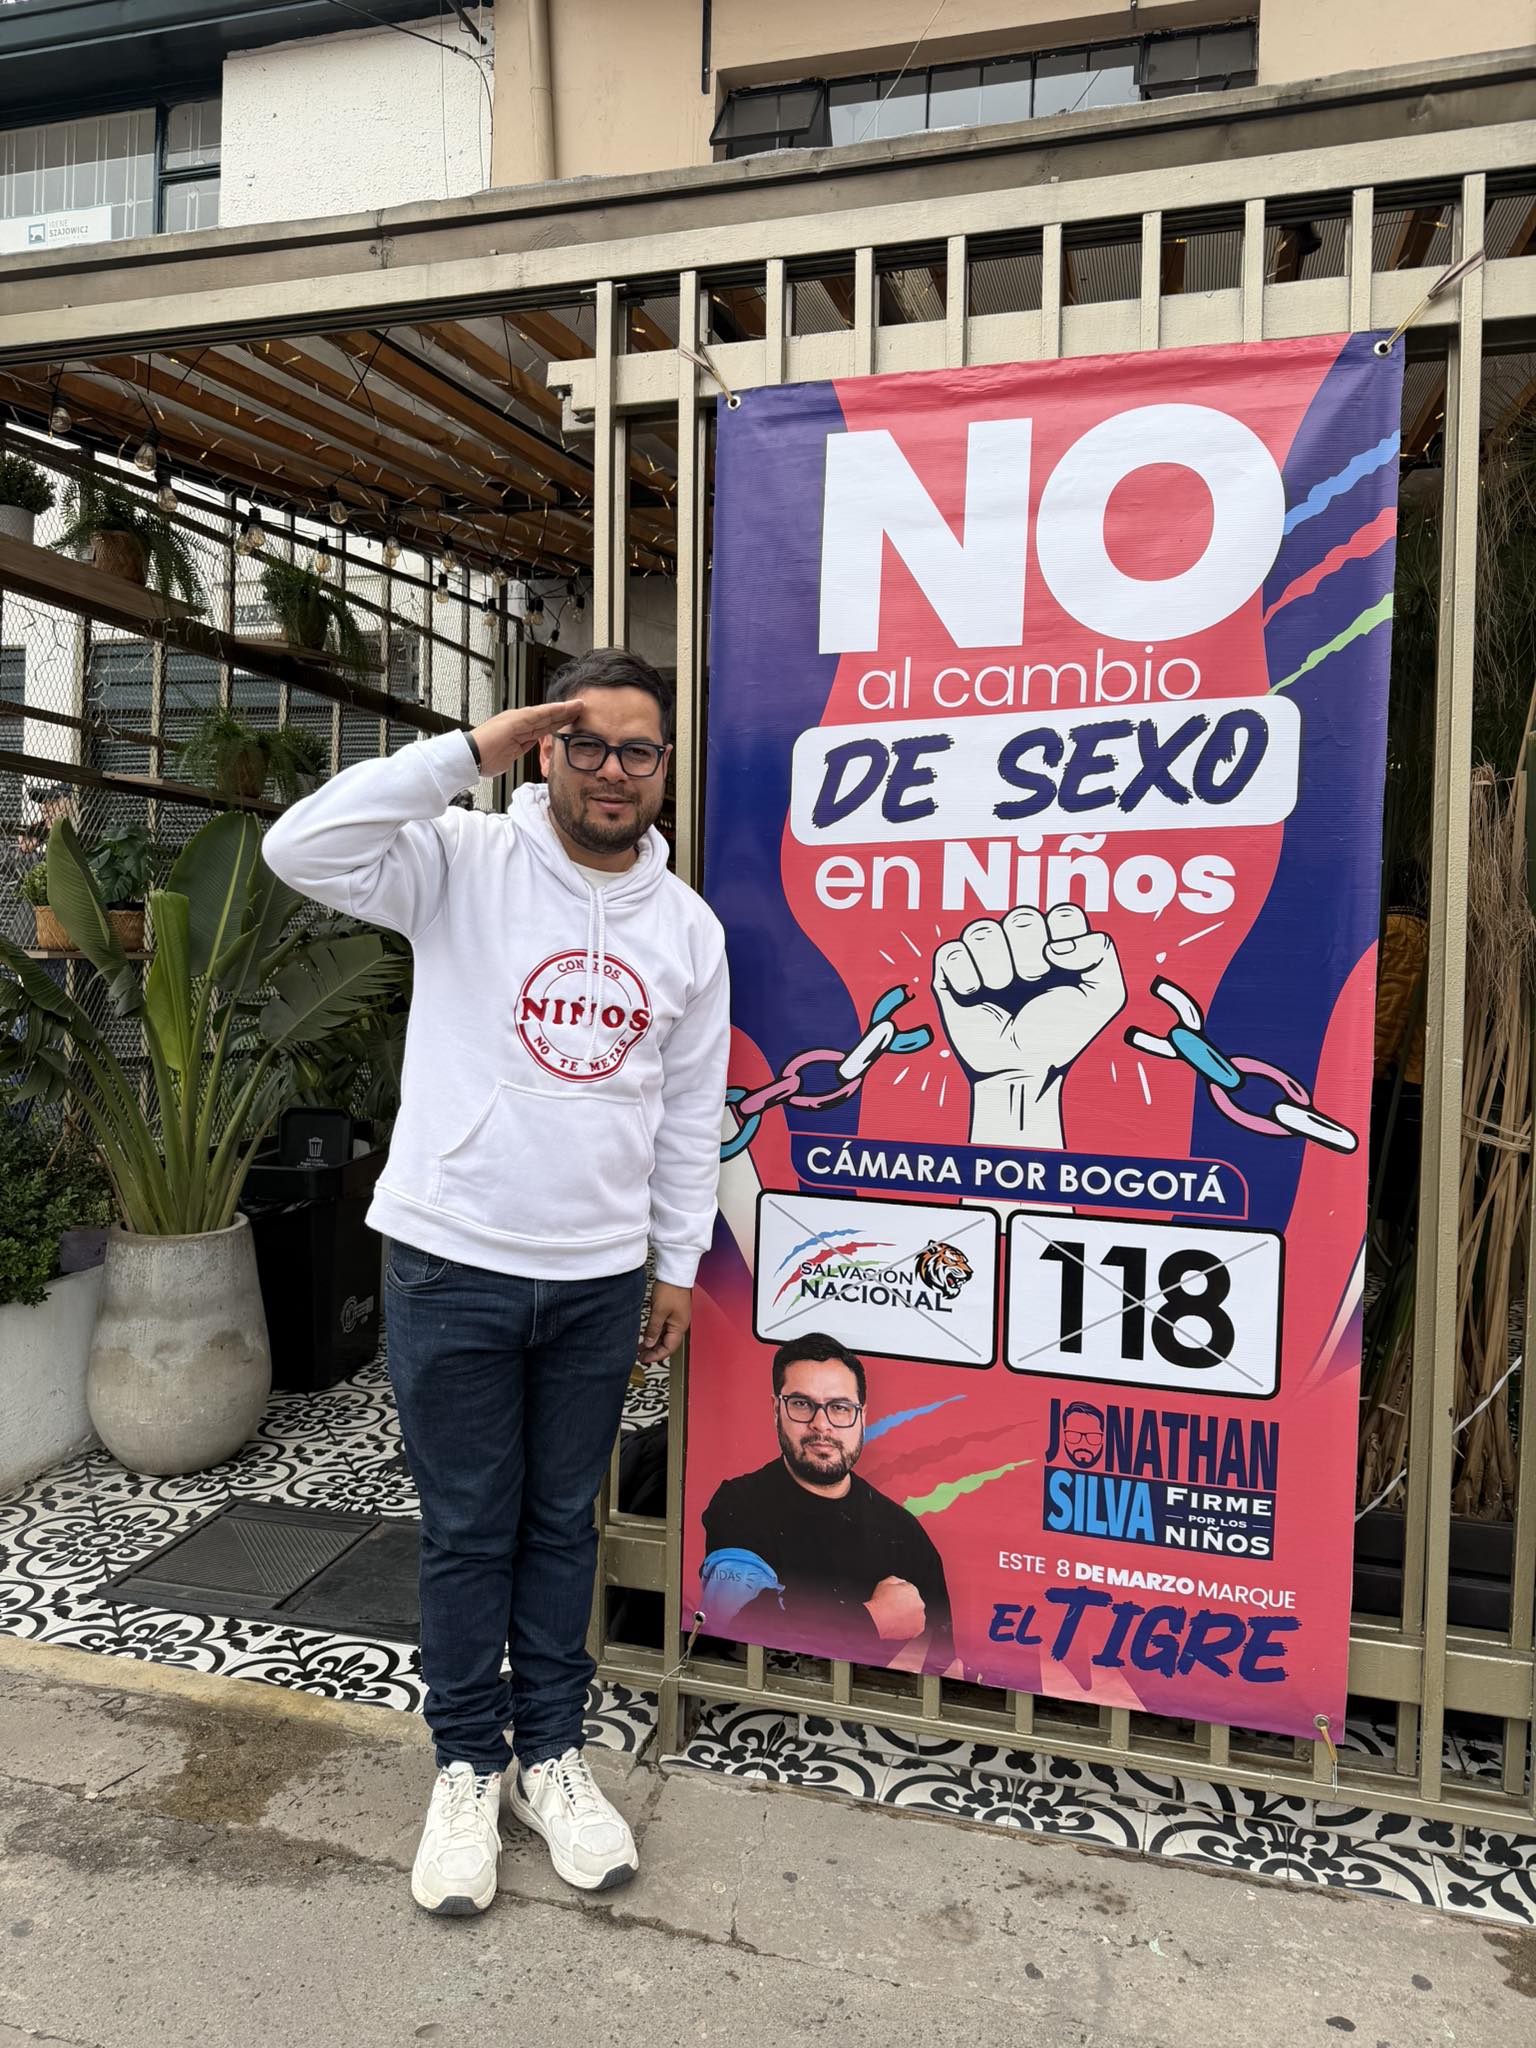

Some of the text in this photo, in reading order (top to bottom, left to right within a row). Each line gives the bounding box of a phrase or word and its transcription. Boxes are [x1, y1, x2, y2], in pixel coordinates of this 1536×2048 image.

[49, 226, 89, 237] SZAJOWICZ
[818, 402, 1286, 655] NO
[857, 645, 1202, 711] al cambio
[811, 708, 1269, 829] DE SEXO
[815, 833, 1236, 920] en Niños
[557, 959, 585, 973] CON
[521, 995, 650, 1032] NIÑOS
[533, 1036, 627, 1072] NO TE METAS
[806, 1145, 1227, 1205] CÁMARA POR BOGOTÁ
[801, 1260, 915, 1285] SALVACIÓN
[800, 1280, 953, 1314] NACIONAL
[1038, 1239, 1236, 1370] 118
[1047, 1469, 1156, 1543] SILVA
[1166, 1485, 1272, 1518] FIRME
[1188, 1514, 1247, 1529] POR LOS
[1165, 1525, 1271, 1556] NIÑOS
[998, 1550, 1046, 1574] ESTE
[1056, 1559, 1070, 1578] 8
[1197, 1579, 1296, 1609] MARQUE
[988, 1585, 1302, 1683] EL TIGRE
